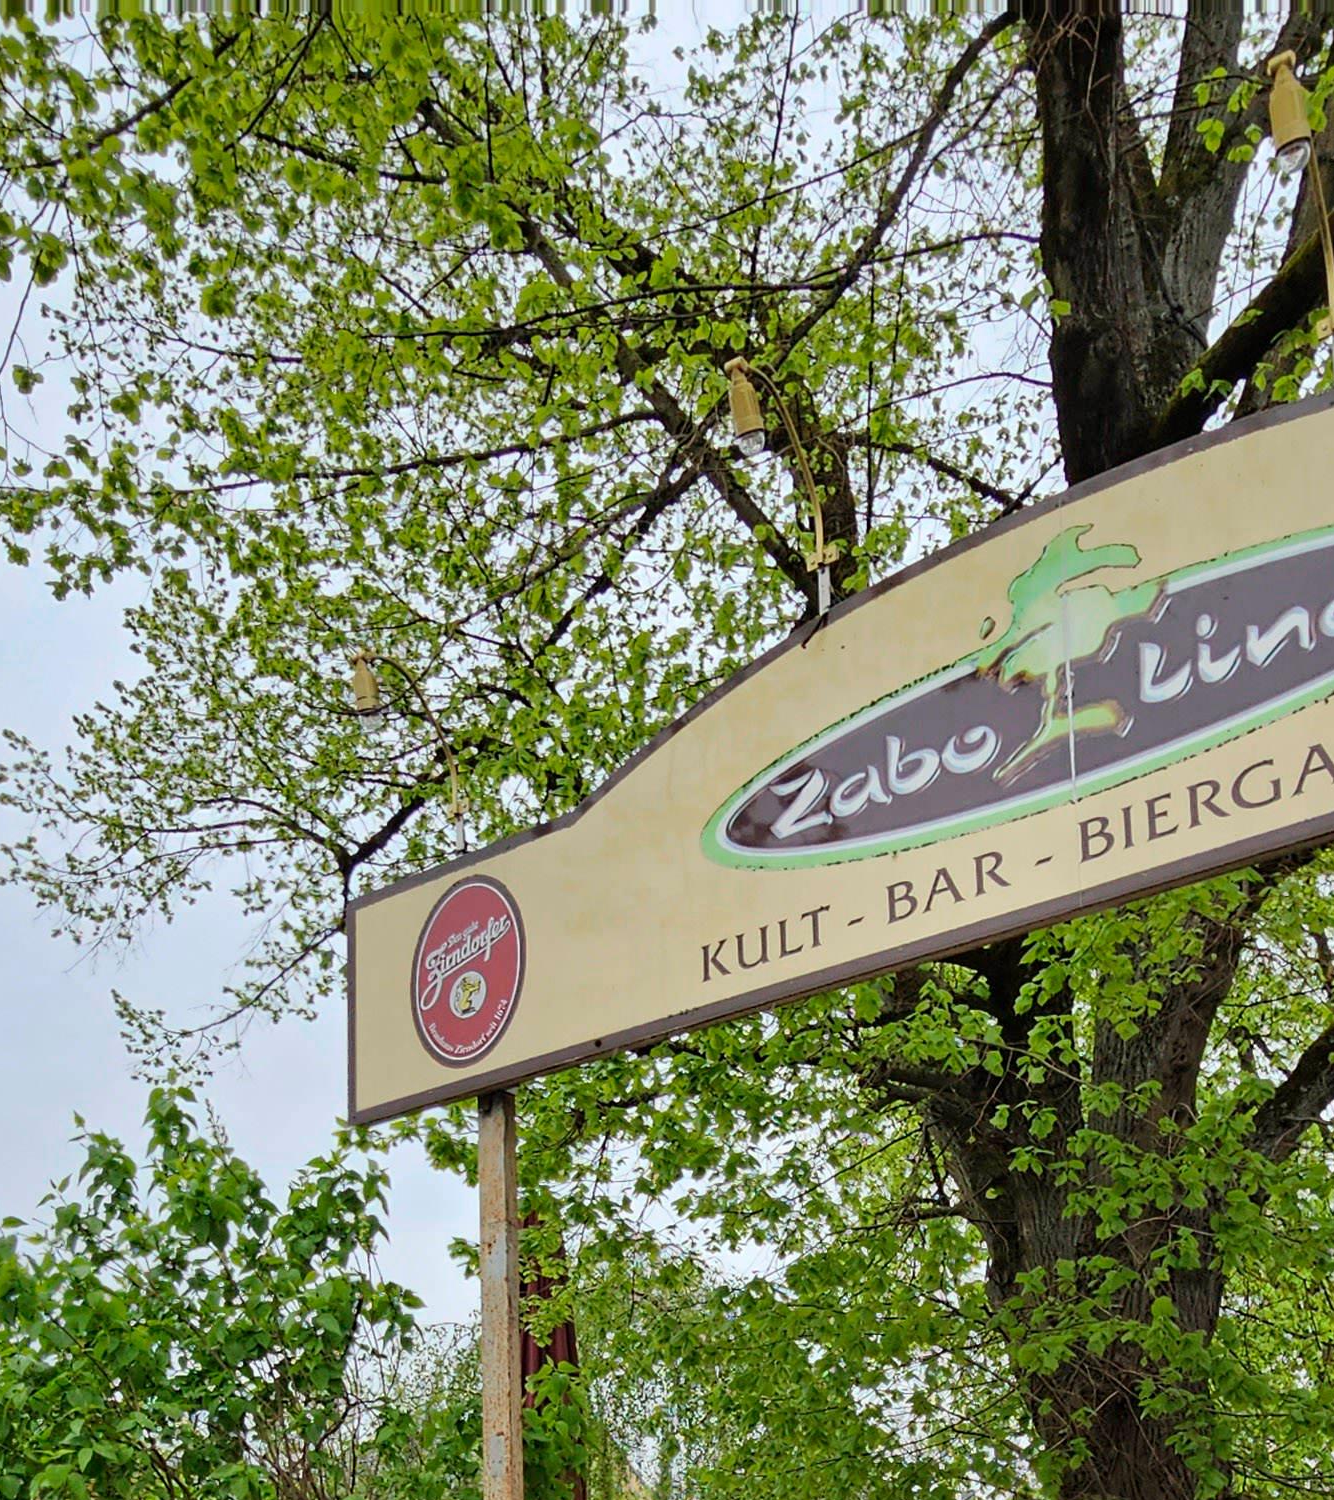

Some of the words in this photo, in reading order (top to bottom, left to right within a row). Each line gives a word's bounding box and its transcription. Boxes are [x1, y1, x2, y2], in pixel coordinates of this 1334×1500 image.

[767, 725, 1002, 840] Zabo
[420, 914, 511, 1011] Zirndorfer
[701, 905, 830, 982] KULT
[887, 850, 1011, 924] BAR
